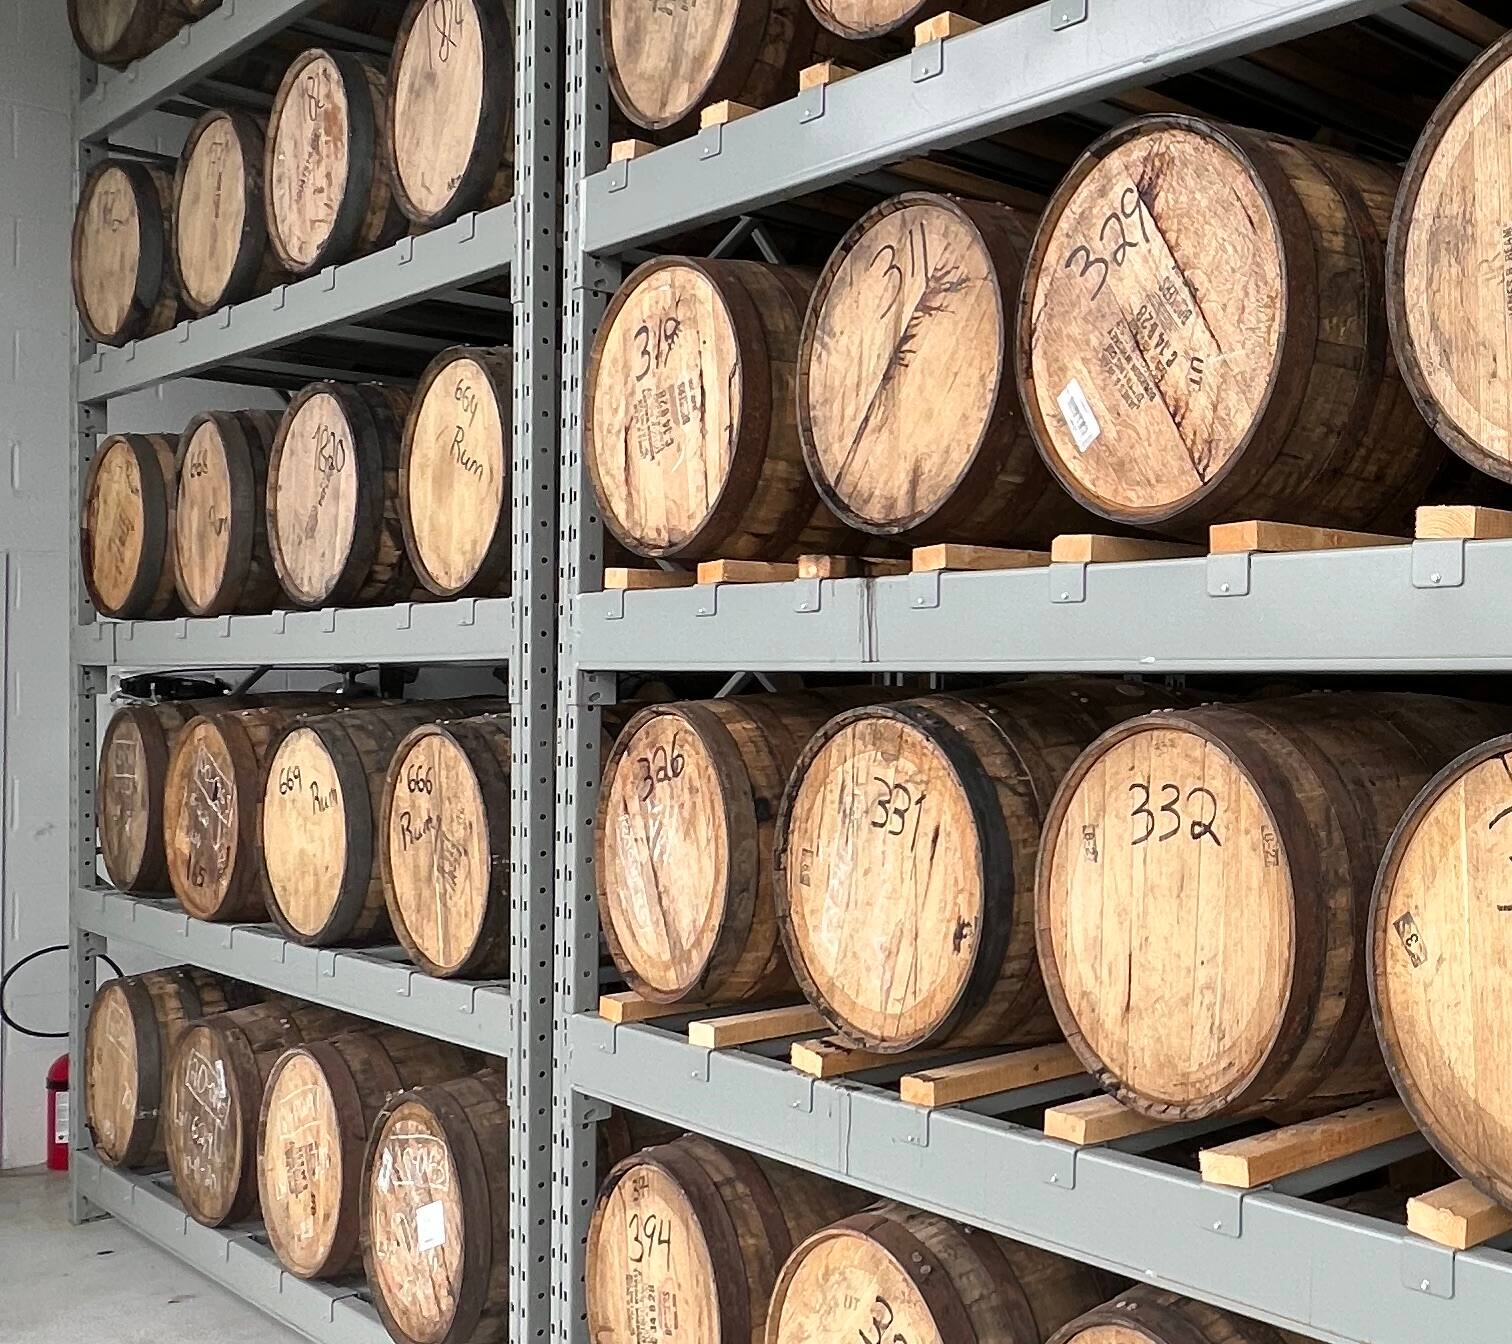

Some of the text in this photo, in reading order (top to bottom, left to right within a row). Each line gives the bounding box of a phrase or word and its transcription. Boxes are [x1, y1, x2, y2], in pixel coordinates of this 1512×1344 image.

[1065, 187, 1151, 302] 329
[450, 425, 485, 483] Rum
[279, 765, 302, 797] 669
[407, 763, 434, 796] 666
[636, 729, 686, 802] 326
[310, 780, 339, 816] Rum
[869, 775, 928, 853] 331
[1127, 782, 1222, 847] 332
[628, 1213, 673, 1273] 394
